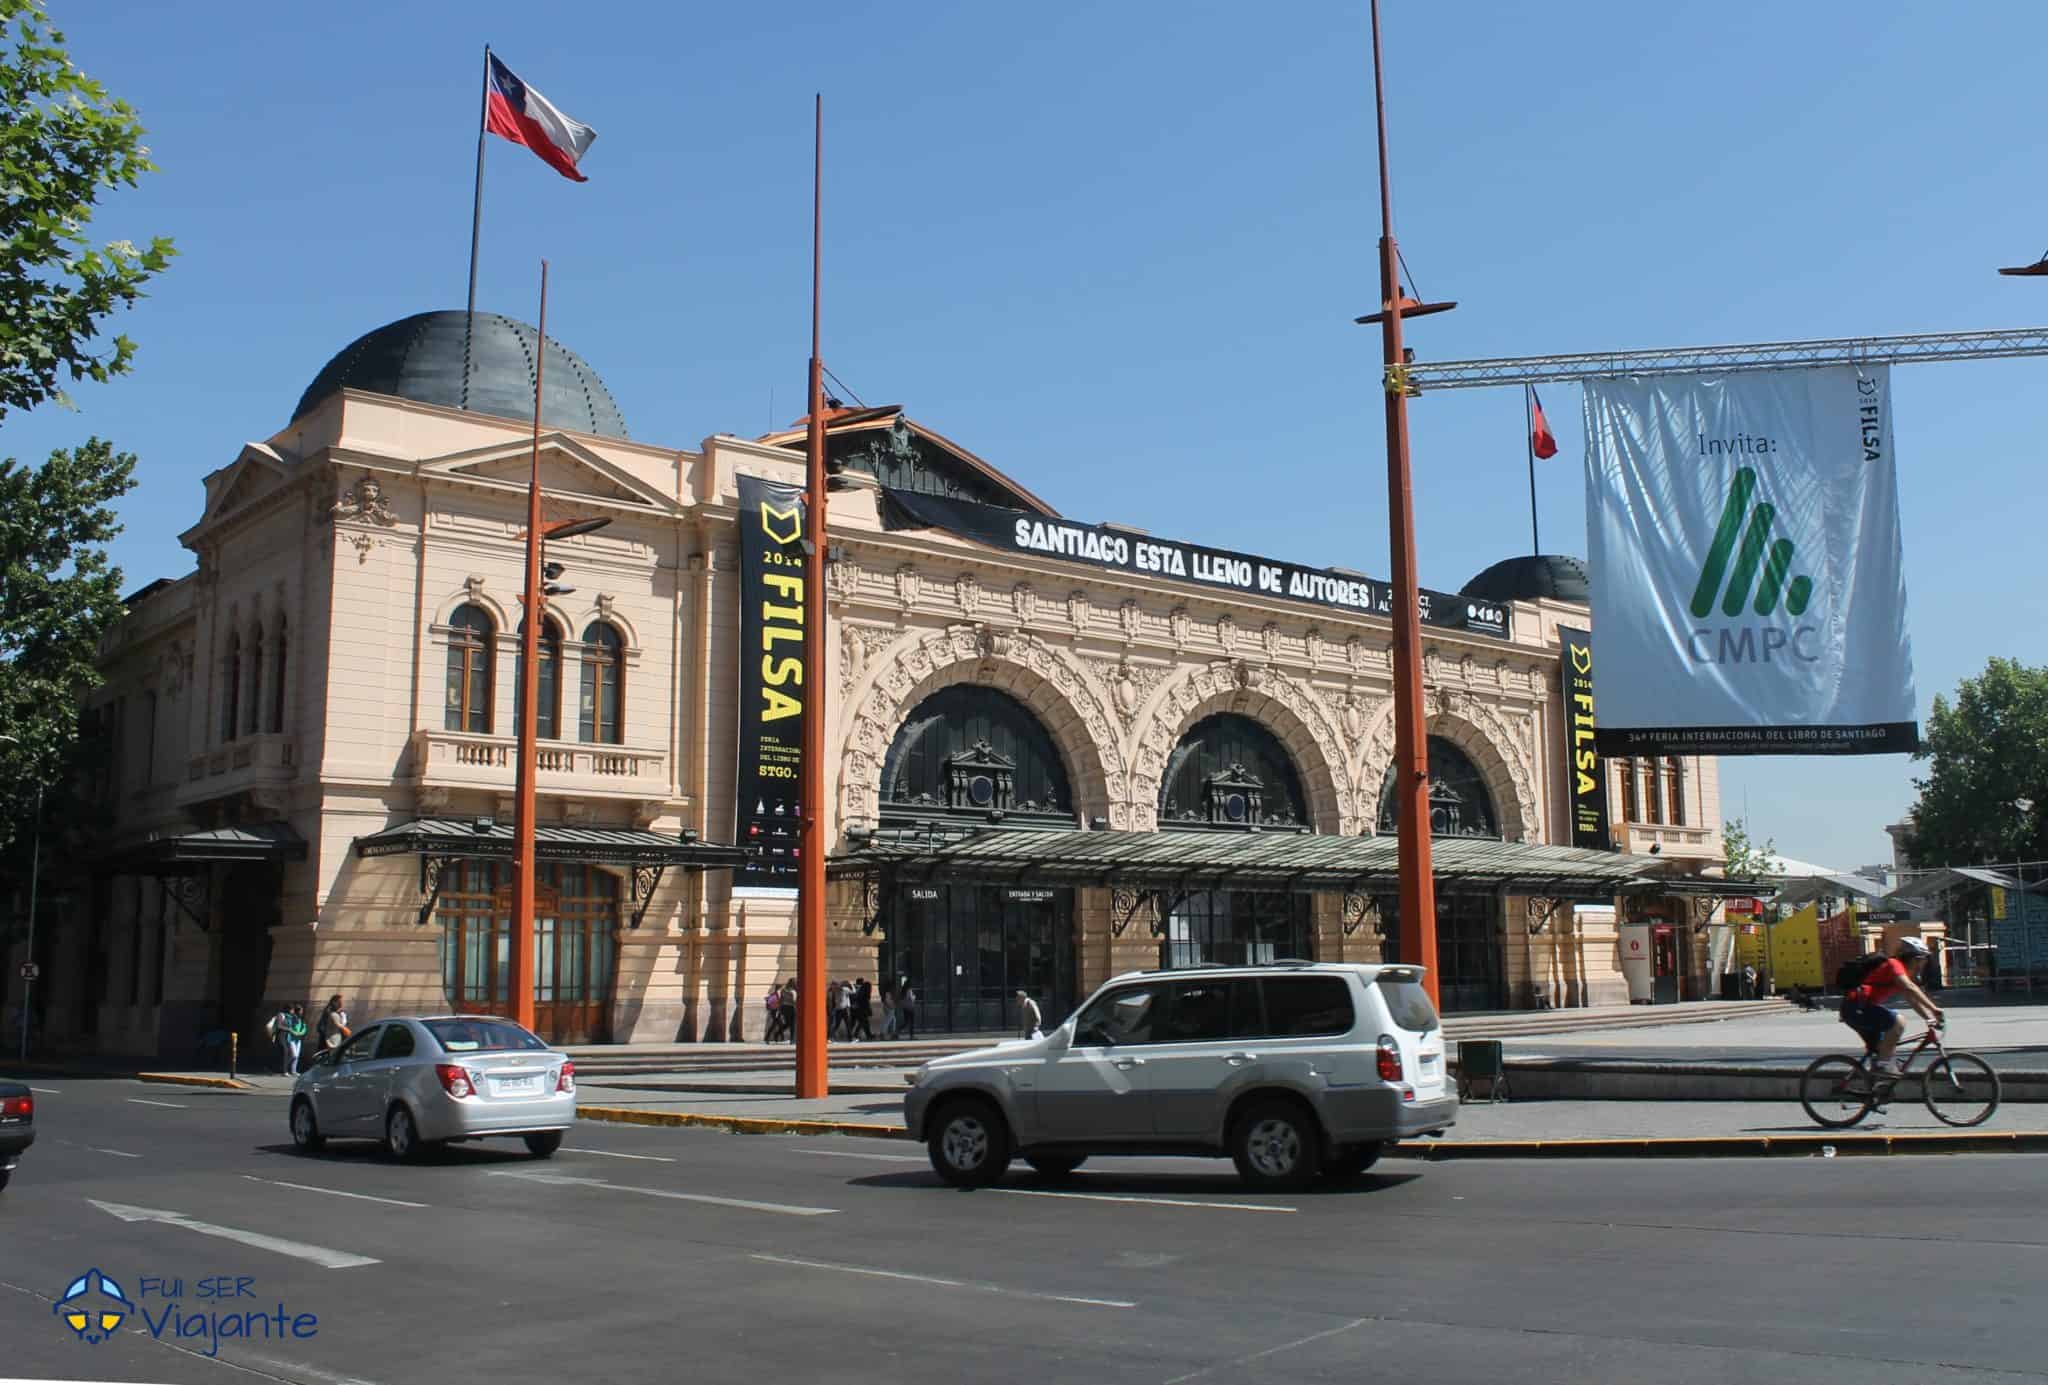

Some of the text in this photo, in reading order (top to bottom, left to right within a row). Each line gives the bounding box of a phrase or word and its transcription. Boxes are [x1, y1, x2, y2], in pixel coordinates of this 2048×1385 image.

[1698, 433, 1777, 455] Invita:
[1860, 406, 1880, 461] FILSA
[763, 551, 802, 567] 2014
[1015, 518, 1369, 608] SANTIAGO ESTA LLENO DE AUTORES
[762, 573, 804, 722] FILSA
[1687, 625, 1819, 665] CMPC
[1574, 693, 1596, 795] FILSA
[1682, 730, 1763, 741] INTERNACIONAL
[1766, 731, 1784, 740] DEL
[1788, 729, 1817, 740] LIBRO
[1820, 728, 1833, 739] DE
[1835, 728, 1886, 739] SANTIAGO
[759, 765, 798, 778] STGO.
[912, 889, 938, 899] SALIDA
